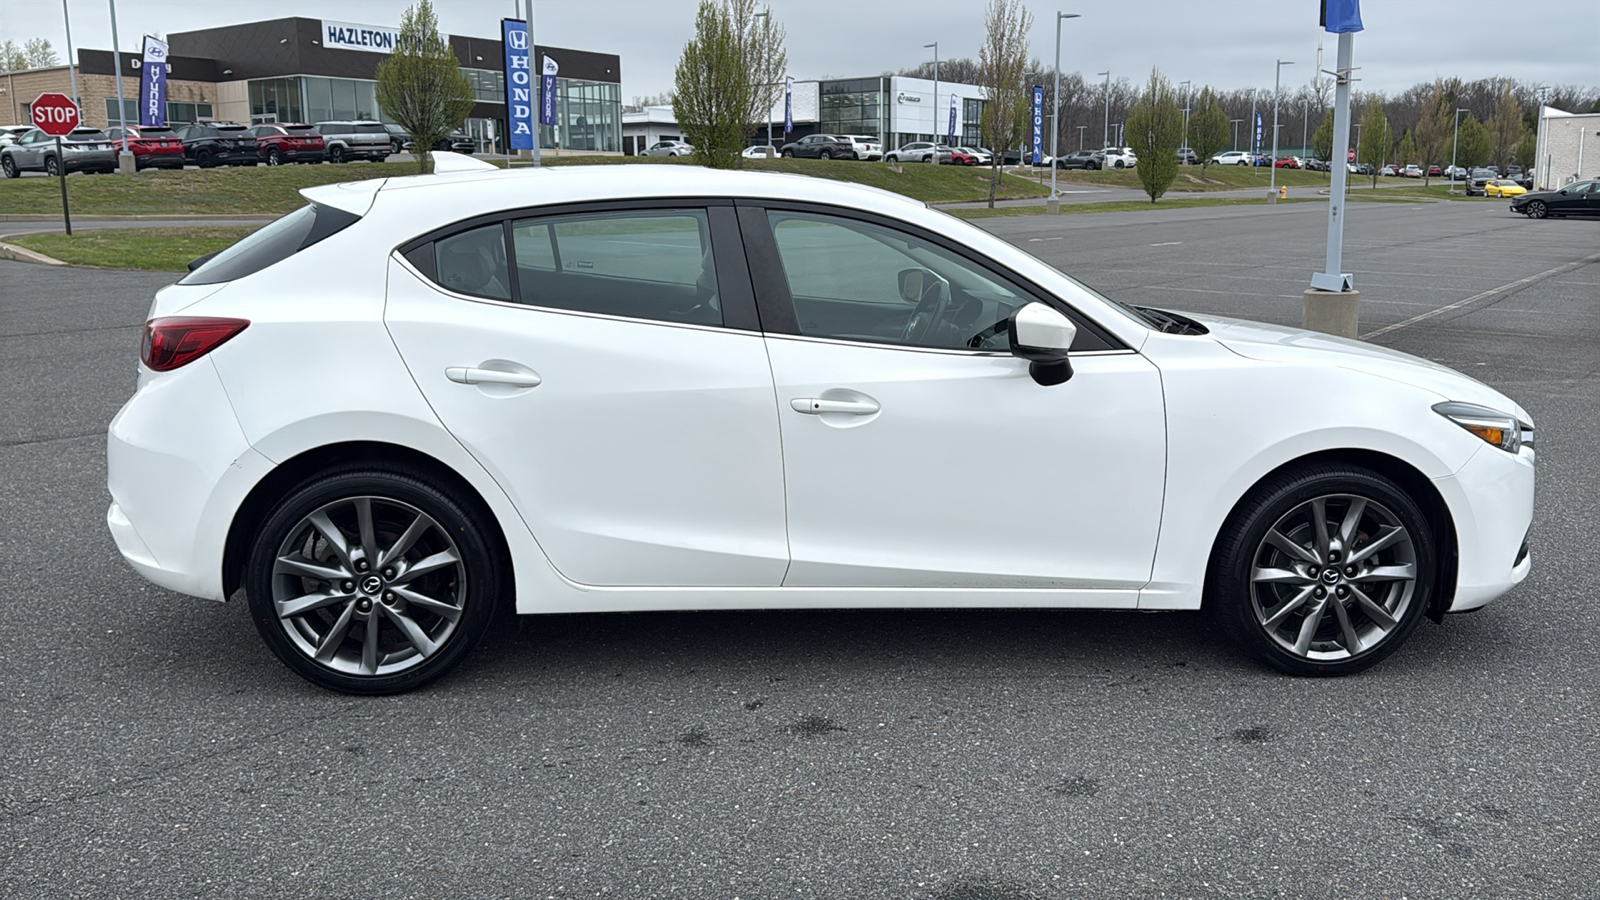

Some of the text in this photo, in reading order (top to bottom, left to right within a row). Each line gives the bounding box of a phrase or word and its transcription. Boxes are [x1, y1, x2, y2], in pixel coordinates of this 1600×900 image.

[328, 26, 392, 48] HAZLETON
[35, 106, 76, 123] STOP
[149, 65, 160, 125] HYUNDAI
[510, 55, 531, 135] HONDA
[1033, 107, 1042, 155] HONDA
